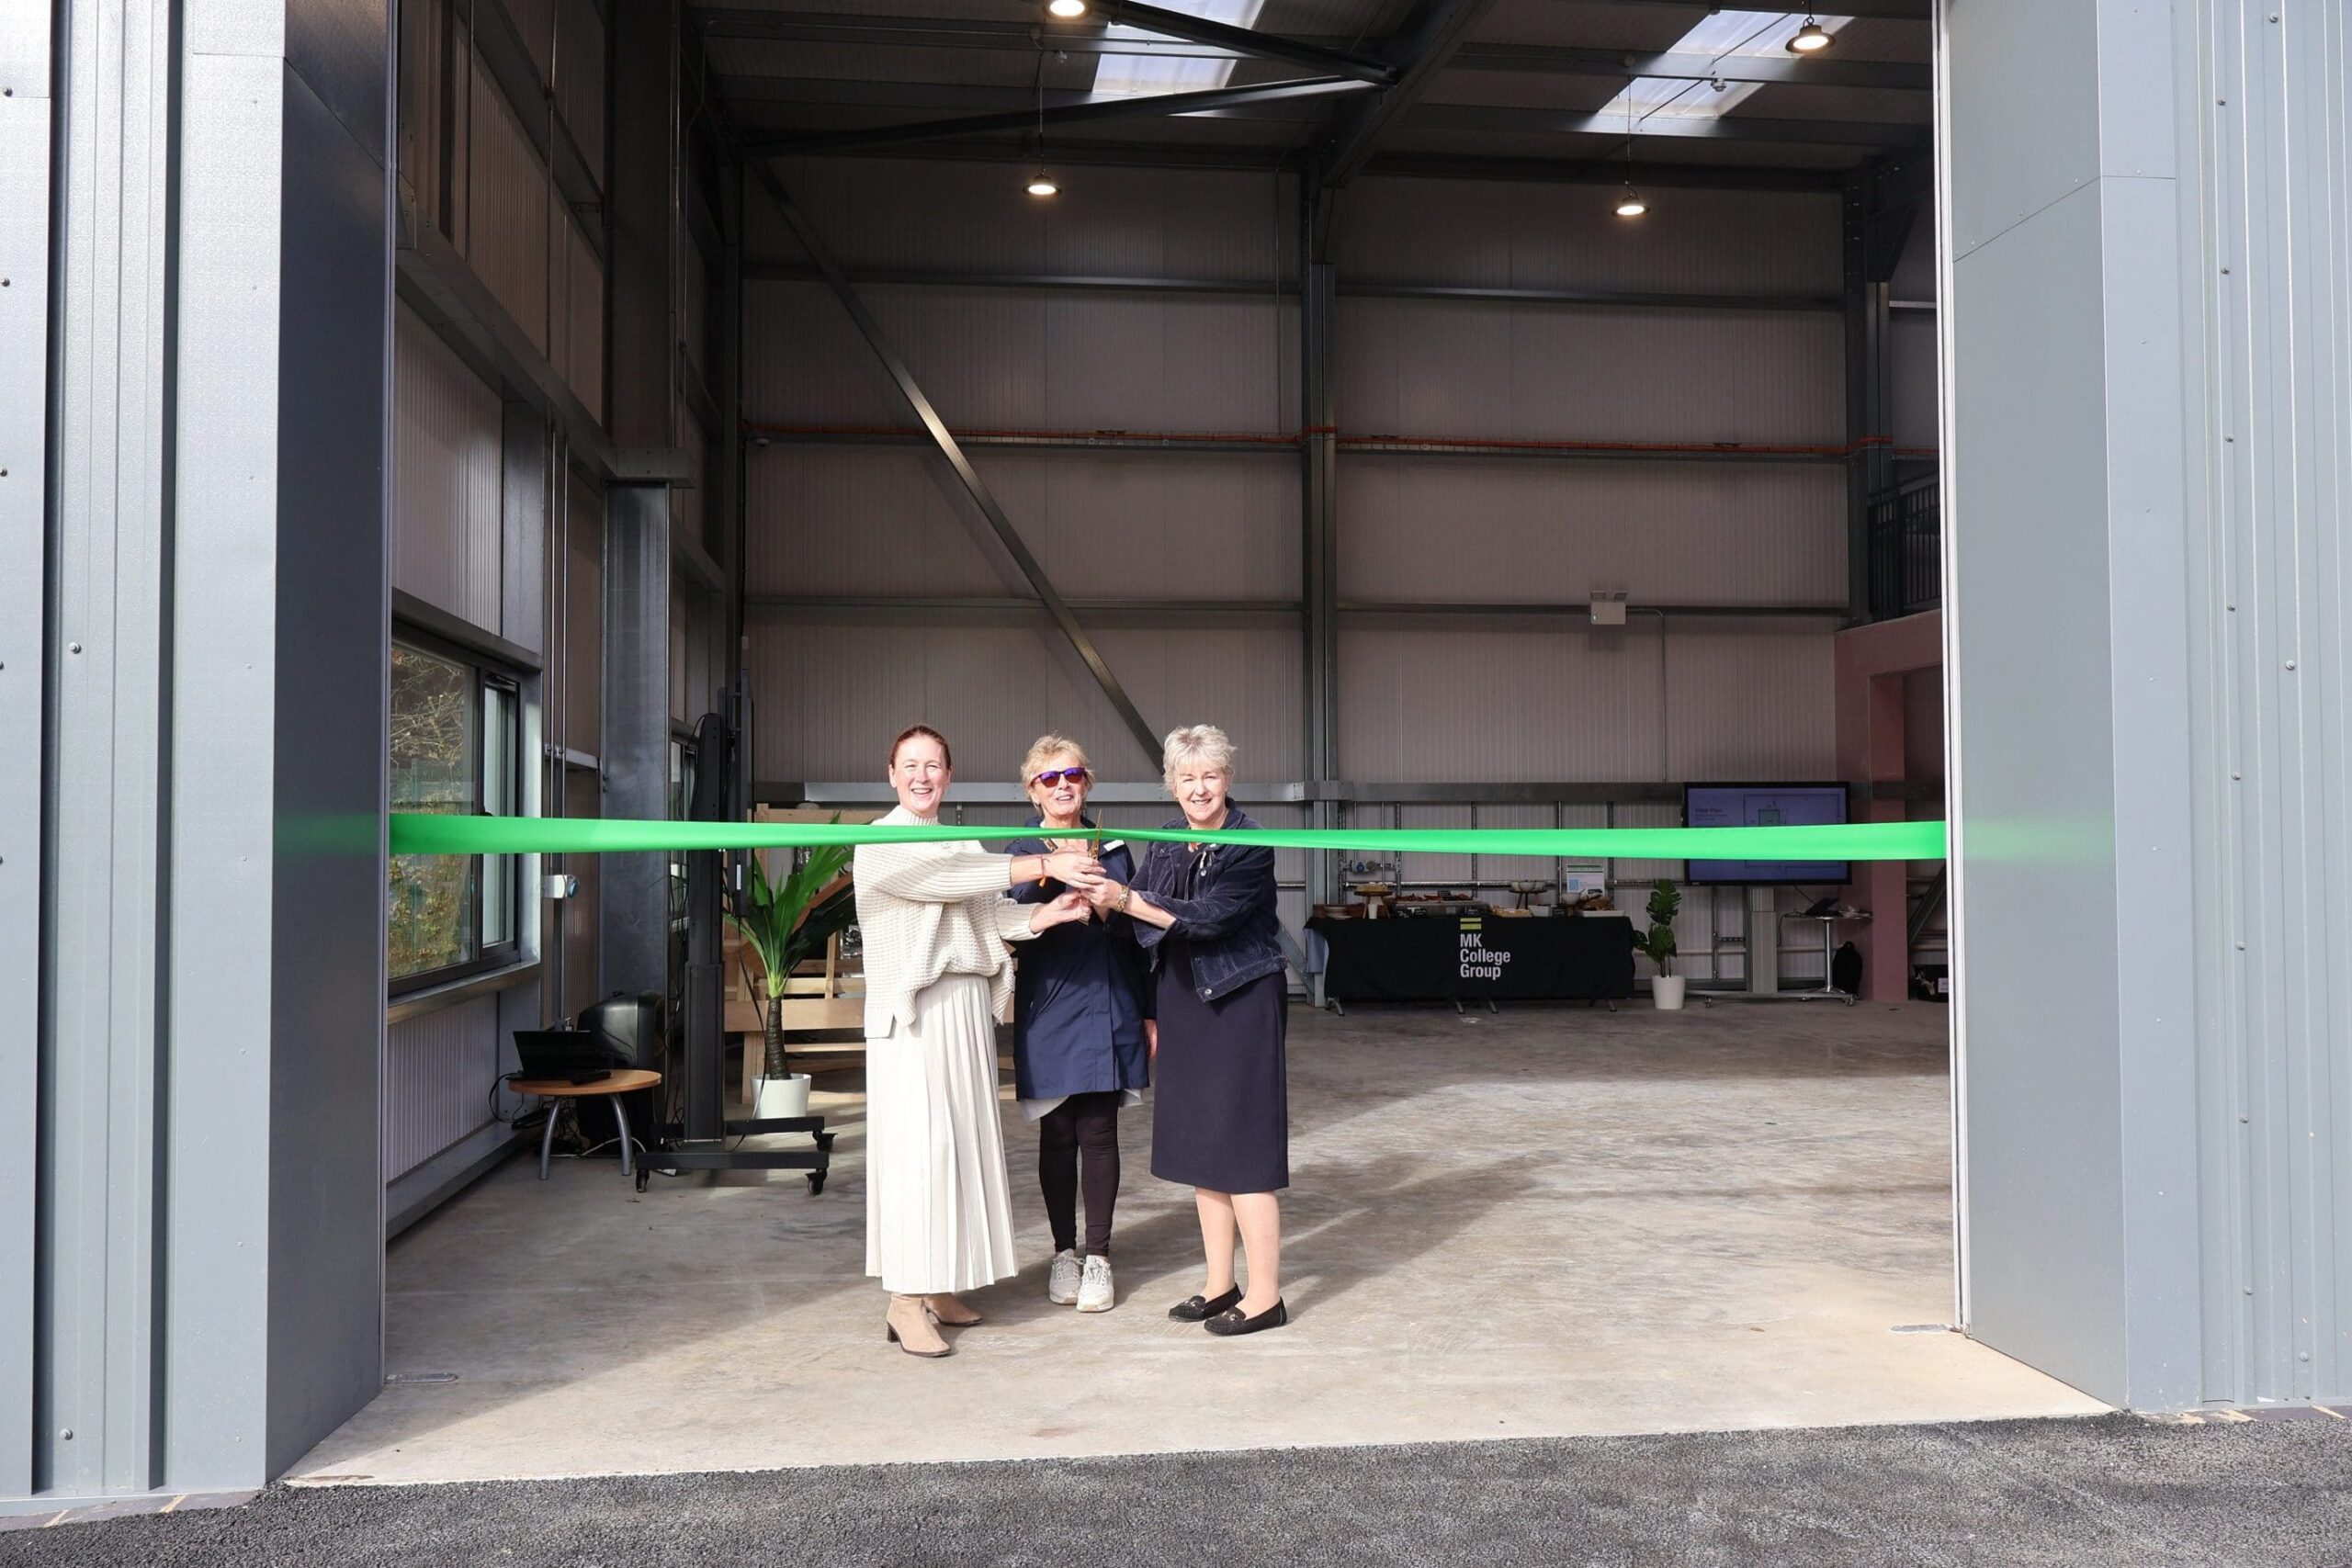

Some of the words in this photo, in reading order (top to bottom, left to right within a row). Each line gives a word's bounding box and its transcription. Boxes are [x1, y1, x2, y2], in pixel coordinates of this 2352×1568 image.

[1460, 933, 1482, 948] MK
[1460, 948, 1511, 965] College
[1460, 964, 1501, 981] Group
